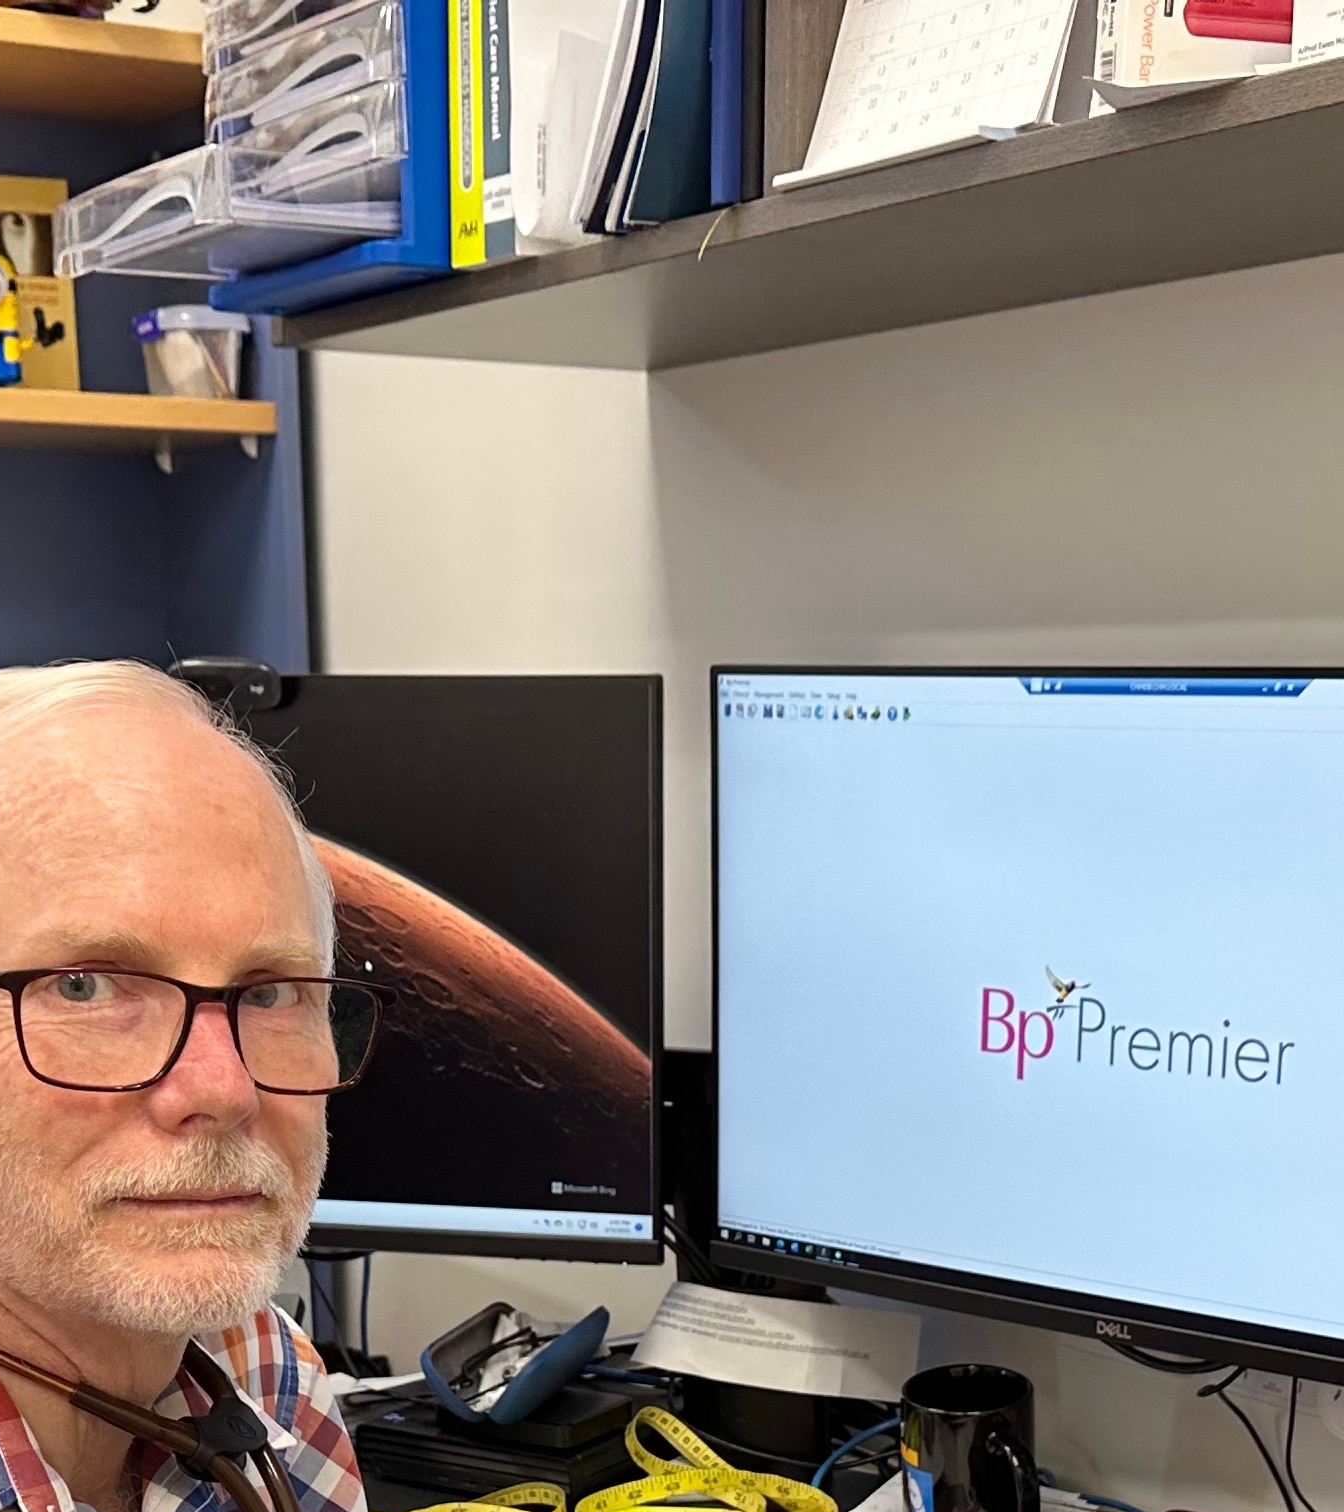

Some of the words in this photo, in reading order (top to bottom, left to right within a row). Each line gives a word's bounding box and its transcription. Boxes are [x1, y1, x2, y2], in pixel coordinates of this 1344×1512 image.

[488, 34, 499, 73] Care
[1139, 54, 1155, 83] Bar
[490, 76, 501, 141] Manual
[980, 987, 1054, 1080] Bp
[1077, 996, 1295, 1085] Premier
[1096, 1320, 1132, 1340] DELL
